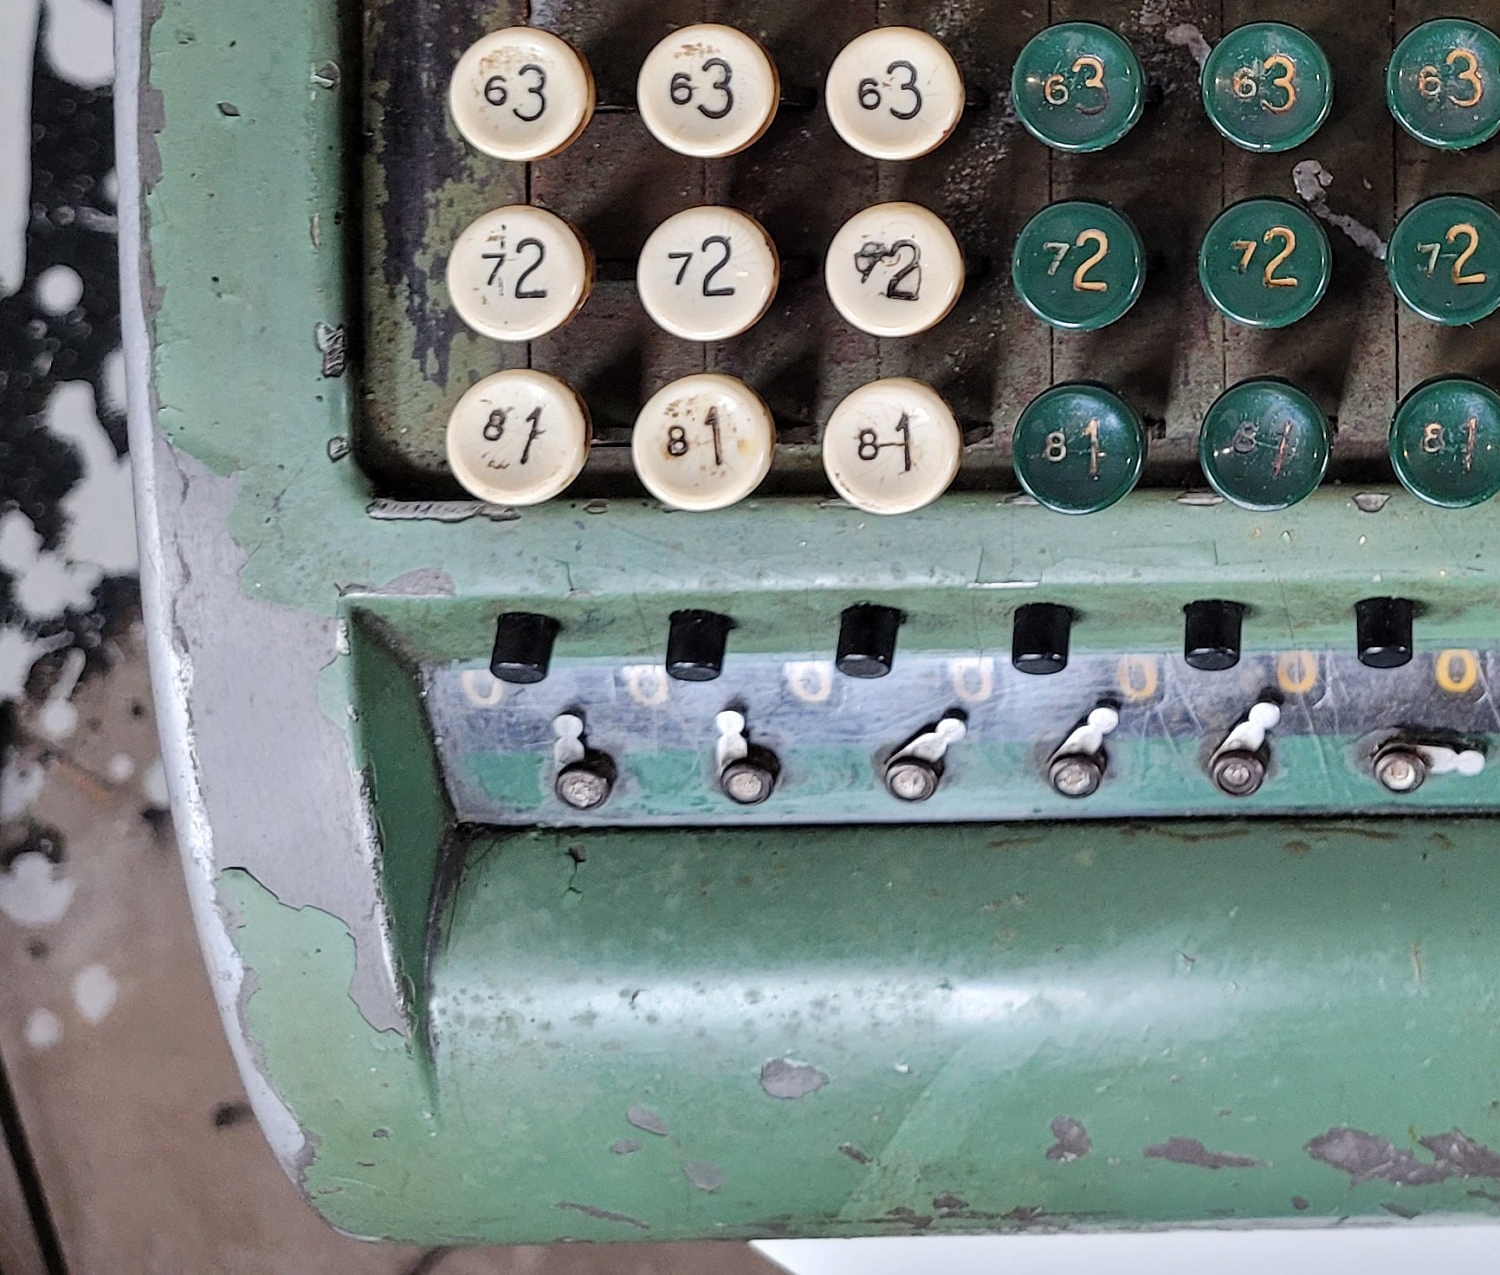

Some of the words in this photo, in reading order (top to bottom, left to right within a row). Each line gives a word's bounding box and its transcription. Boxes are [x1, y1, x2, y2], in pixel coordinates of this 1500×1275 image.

[483, 63, 547, 123] 63
[669, 57, 734, 120] 63
[857, 59, 922, 121] 63
[667, 234, 736, 297] 72
[1042, 228, 1109, 294] 72
[1232, 225, 1299, 289] 72
[1416, 222, 1488, 285] 72
[668, 405, 724, 466] 81
[1119, 652, 1157, 699] 0
[1278, 648, 1318, 693] 0
[1436, 647, 1478, 692] 0
